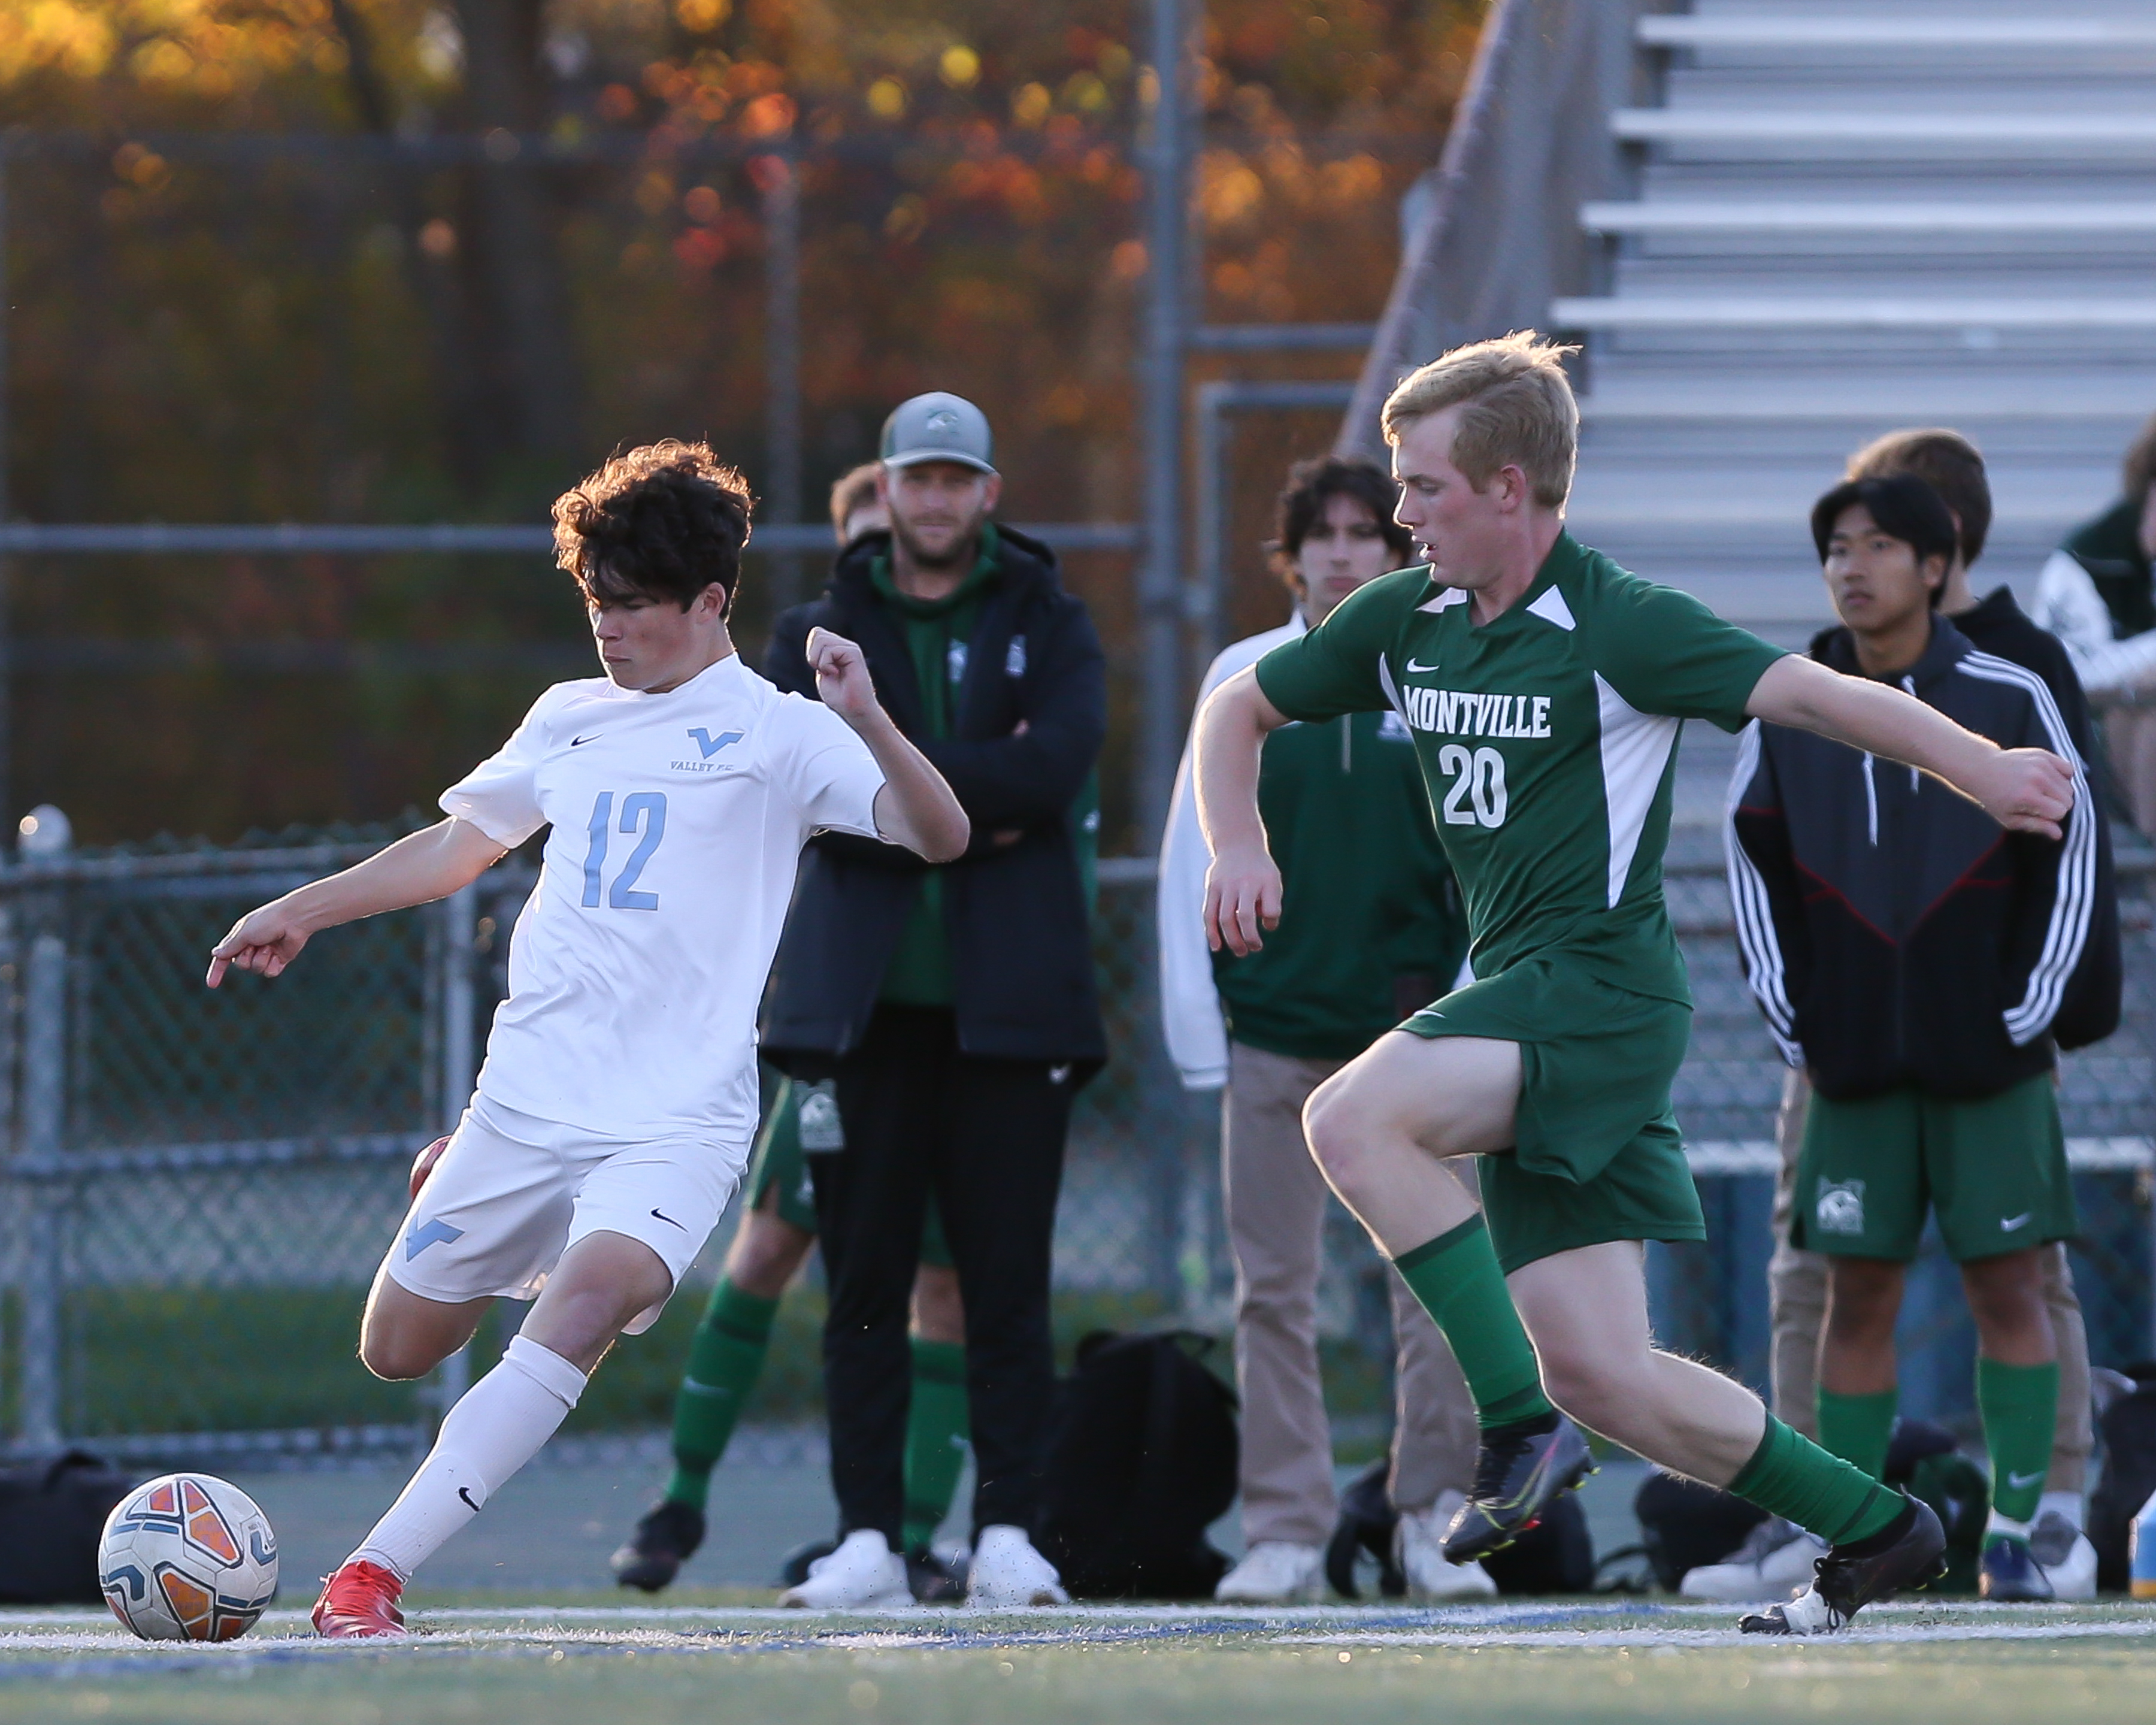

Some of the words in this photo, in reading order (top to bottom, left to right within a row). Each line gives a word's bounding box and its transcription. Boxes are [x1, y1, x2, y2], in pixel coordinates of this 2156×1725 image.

[1404, 685, 1551, 738] MONTVILLE
[670, 761, 714, 771] VALLEY
[1439, 744, 1507, 828] 20
[581, 791, 667, 910] 12
